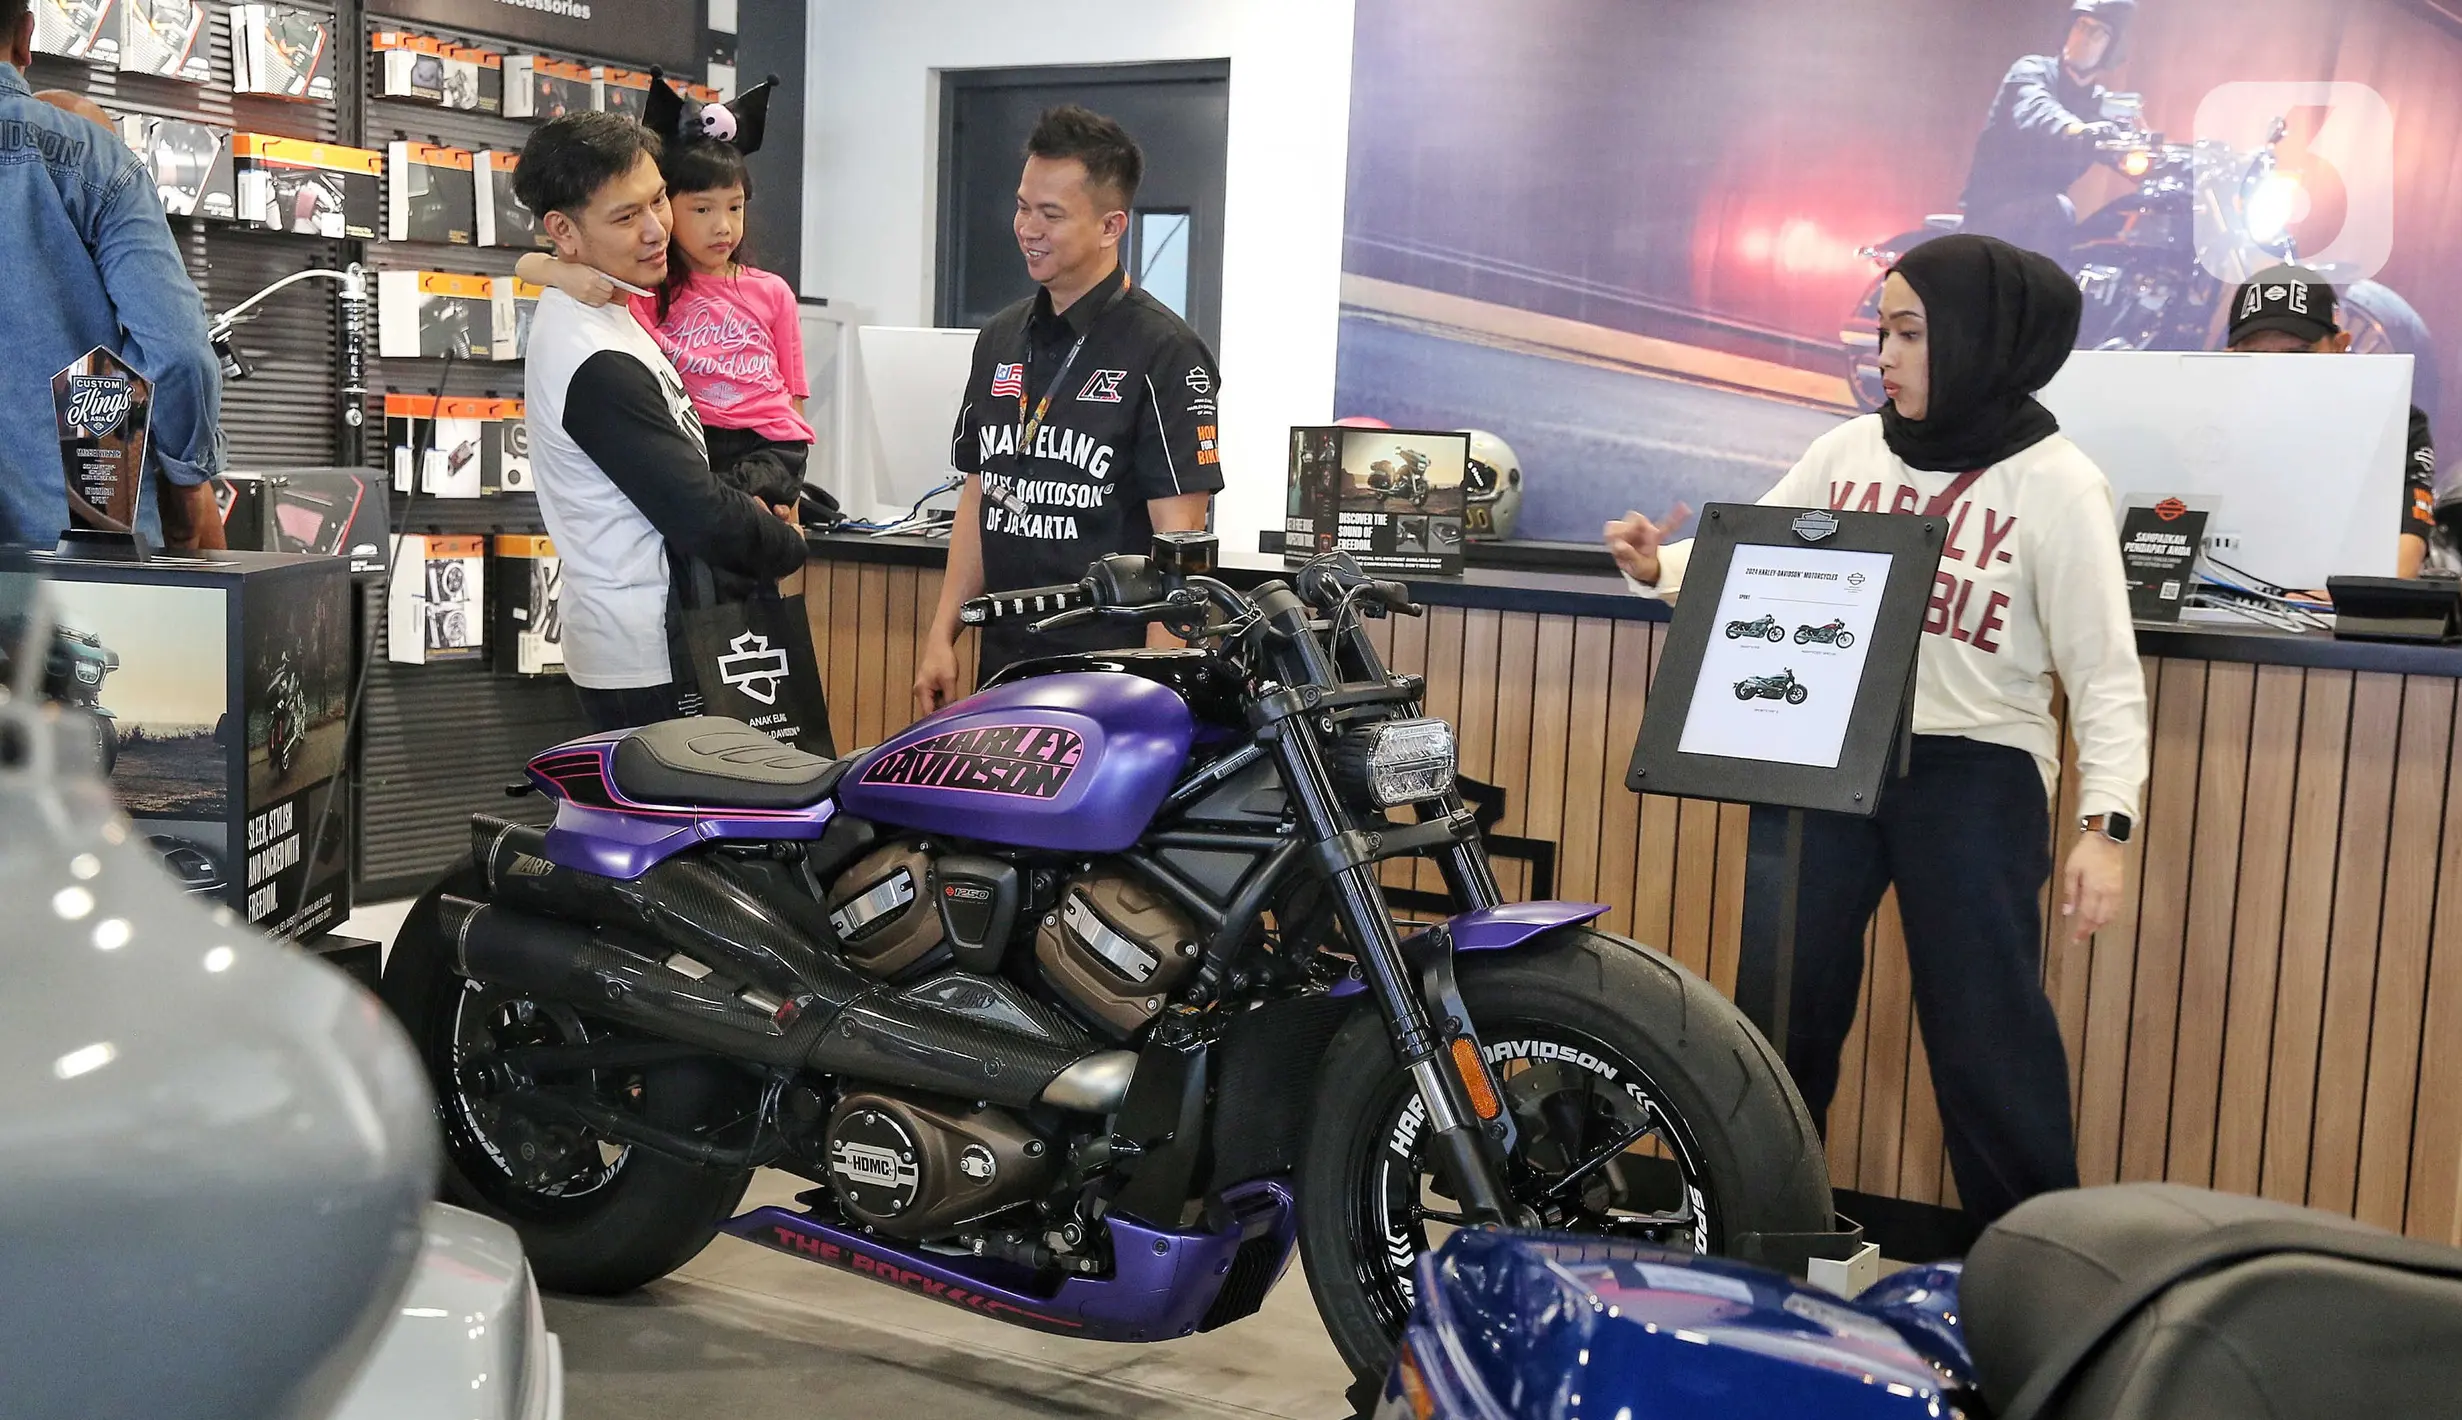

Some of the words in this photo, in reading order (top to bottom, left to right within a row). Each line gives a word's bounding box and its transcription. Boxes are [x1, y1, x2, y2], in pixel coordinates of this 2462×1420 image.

[493, 0, 591, 19] cessories
[2240, 282, 2262, 319] A
[2288, 279, 2308, 314] E
[667, 304, 762, 353] Harley
[665, 346, 775, 384] Davidson
[76, 379, 121, 389] CUSTOM
[1034, 425, 1115, 480] ELANG
[986, 506, 1004, 532] OF
[1003, 510, 1079, 540] JAKARTA
[1338, 525, 1363, 538] SOUND
[1363, 526, 1374, 538] OF
[1339, 512, 1373, 525] DISCOVER
[1374, 513, 1388, 526] THE
[1338, 538, 1373, 551] FREEDOM.
[1803, 571, 1839, 581] MOTORCYCLES
[750, 714, 773, 727] ANAK
[922, 727, 1084, 767] HARLEY
[862, 751, 1072, 798] DAVIDSON
[248, 813, 269, 850] SLEEK,
[269, 801, 293, 840] STYLISH
[248, 853, 262, 888] AND
[262, 841, 285, 881] PACKED
[284, 833, 300, 868] WITH
[248, 881, 279, 924] FREEDOM.
[954, 888, 990, 900] 1250
[852, 1155, 890, 1176] HDMC
[1687, 1184, 1708, 1256] SPO
[773, 1226, 841, 1261] THE
